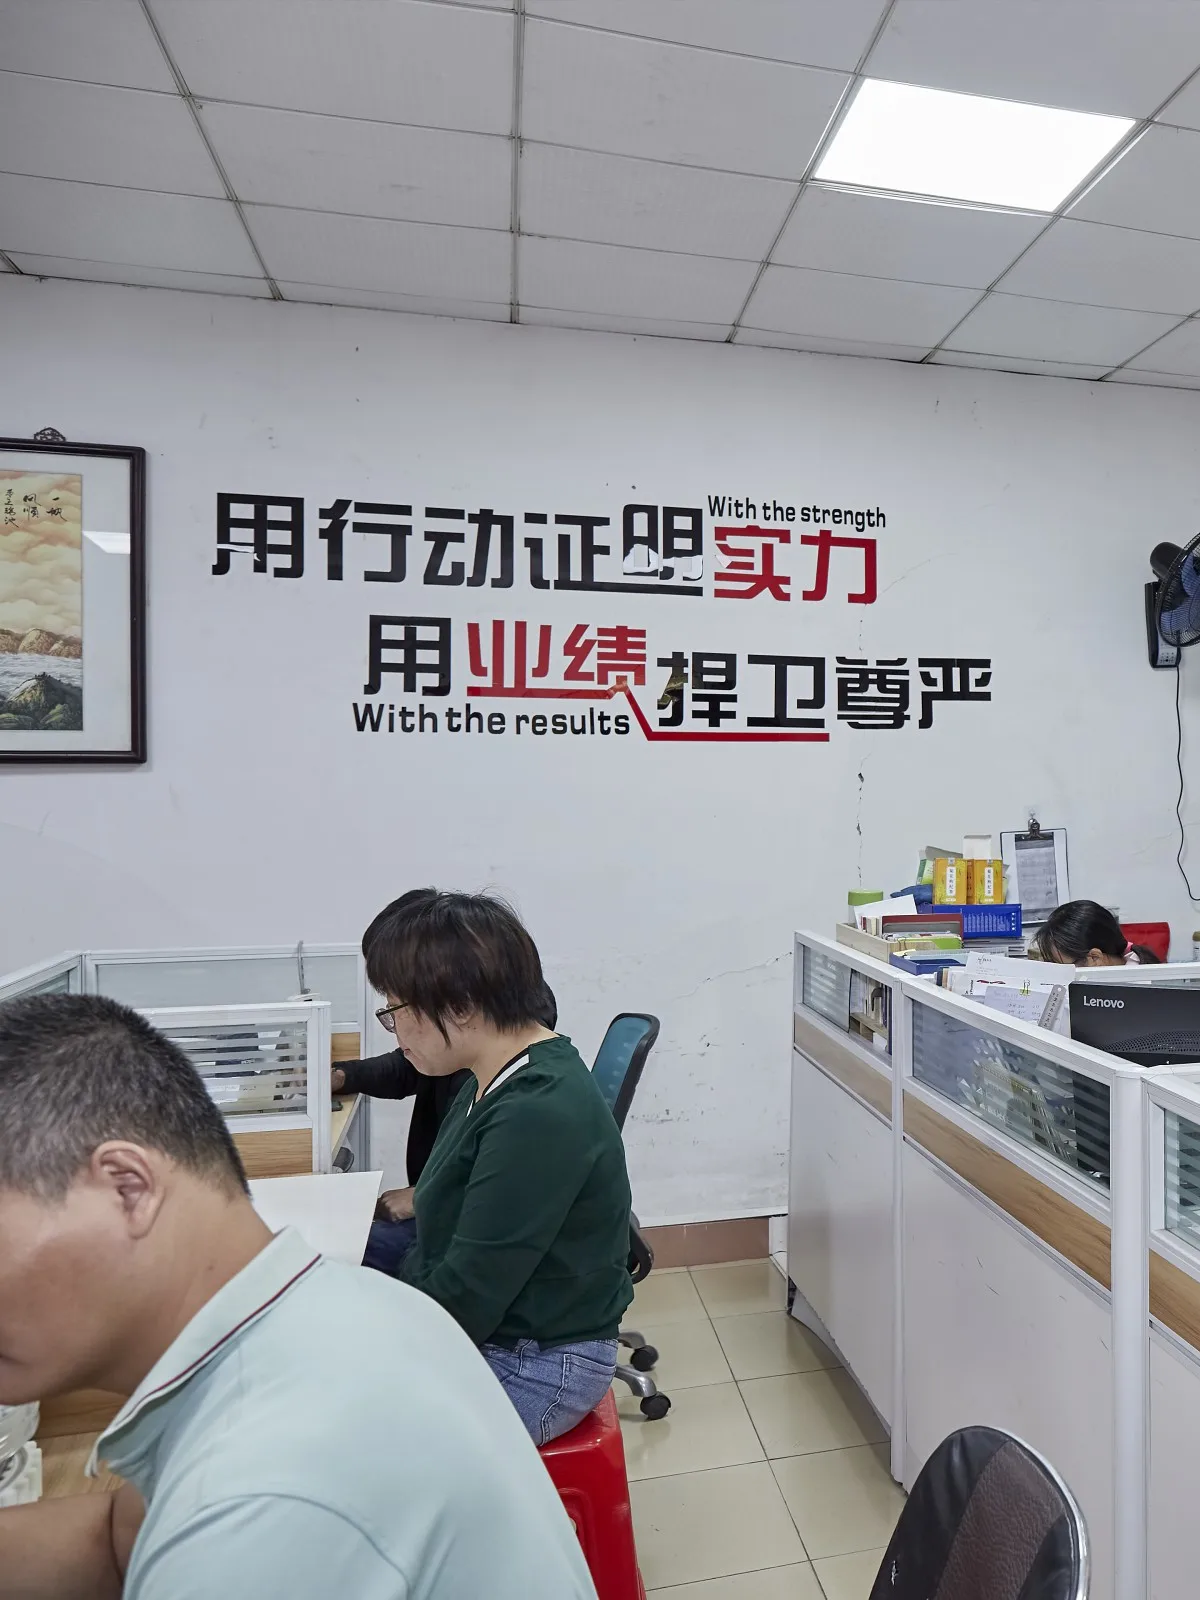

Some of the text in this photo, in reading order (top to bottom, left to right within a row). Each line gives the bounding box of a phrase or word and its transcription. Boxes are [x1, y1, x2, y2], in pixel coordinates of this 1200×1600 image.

[707, 494, 887, 533] With the strength
[212, 491, 878, 604] 用行动证明实力
[363, 614, 993, 731] 用业绩捍卫尊严
[352, 702, 630, 736] With the results
[1083, 995, 1125, 1009] Lenovo
